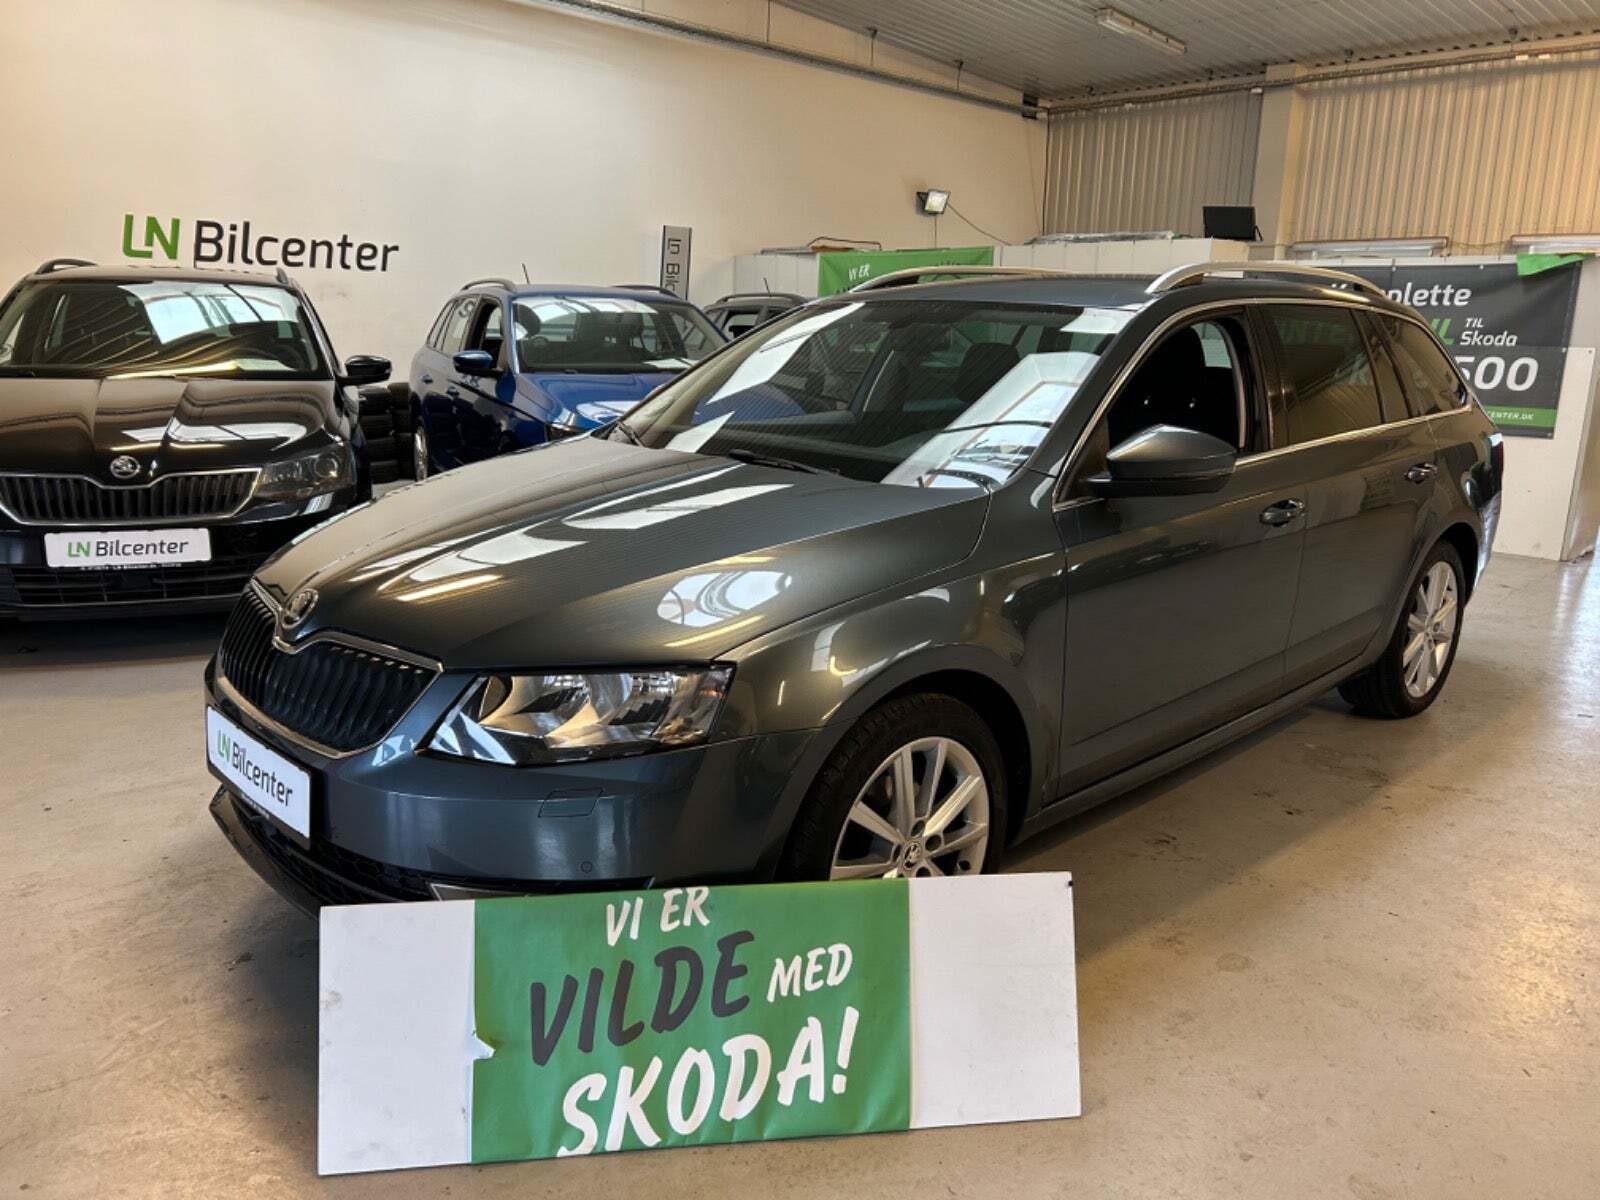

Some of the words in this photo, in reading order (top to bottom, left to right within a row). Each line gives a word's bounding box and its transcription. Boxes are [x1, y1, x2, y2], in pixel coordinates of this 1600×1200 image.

[122, 213, 180, 260] LN
[193, 219, 400, 272] Bilcenter
[1459, 330, 1519, 347] Skoda
[1465, 317, 1485, 328] TIL
[67, 542, 91, 558] LN
[96, 540, 189, 557] Bilcenter
[218, 730, 230, 762] LN
[232, 742, 293, 806] Bilcenter
[606, 896, 644, 947] VI
[660, 886, 711, 932] ER
[530, 930, 755, 1067] VILDE
[766, 943, 854, 1003] MED
[556, 1006, 860, 1158] SKODA!
